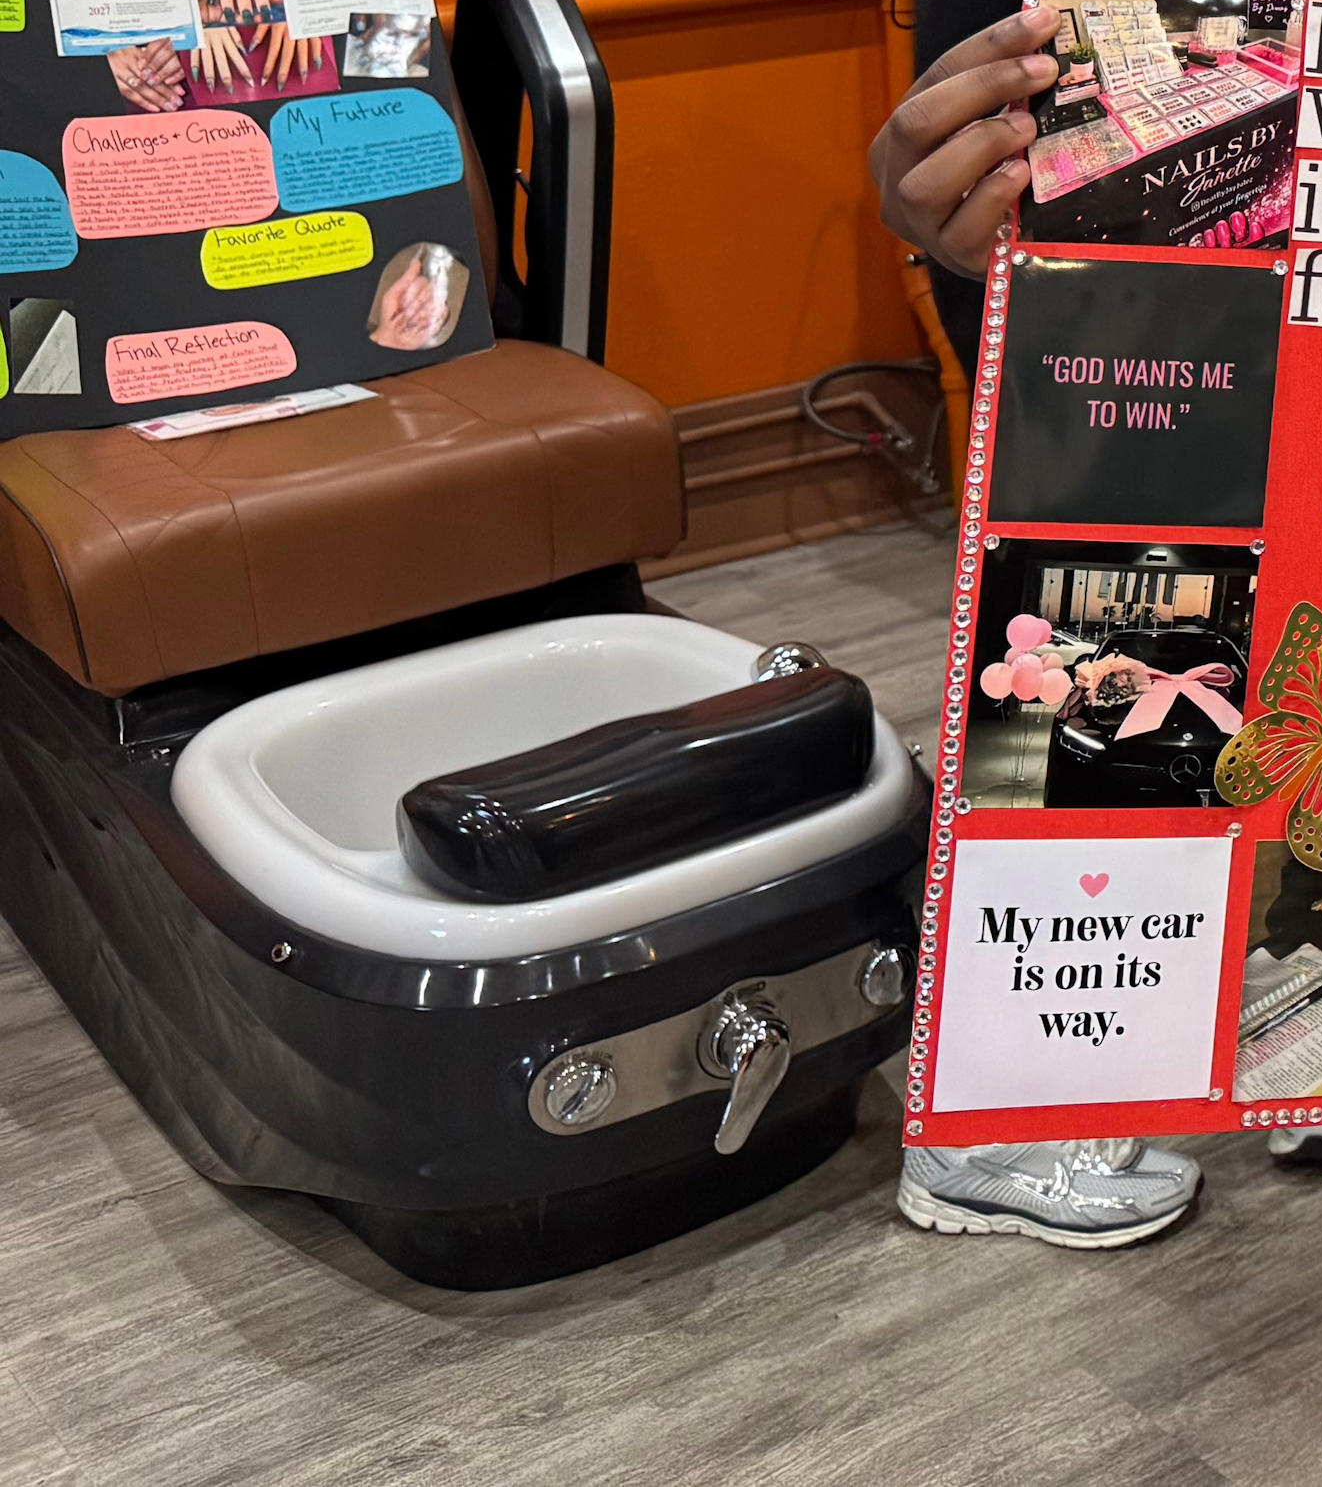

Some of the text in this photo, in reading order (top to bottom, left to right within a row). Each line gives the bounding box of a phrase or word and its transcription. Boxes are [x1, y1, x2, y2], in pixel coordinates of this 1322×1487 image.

[72, 127, 168, 156] Challenges
[185, 119, 257, 145] Growth
[287, 99, 405, 146] My Future
[1142, 135, 1243, 197] NAILS
[1250, 120, 1283, 151] BY
[214, 215, 347, 249] Favorite Quote
[113, 328, 261, 362] Final Reflection
[1113, 359, 1194, 390] WANTS
[1201, 362, 1235, 391] ME
[1087, 400, 1118, 430] TO
[975, 906, 1206, 954] My new car
[1010, 953, 1162, 992] is on its
[1038, 1008, 1125, 1047] way.
